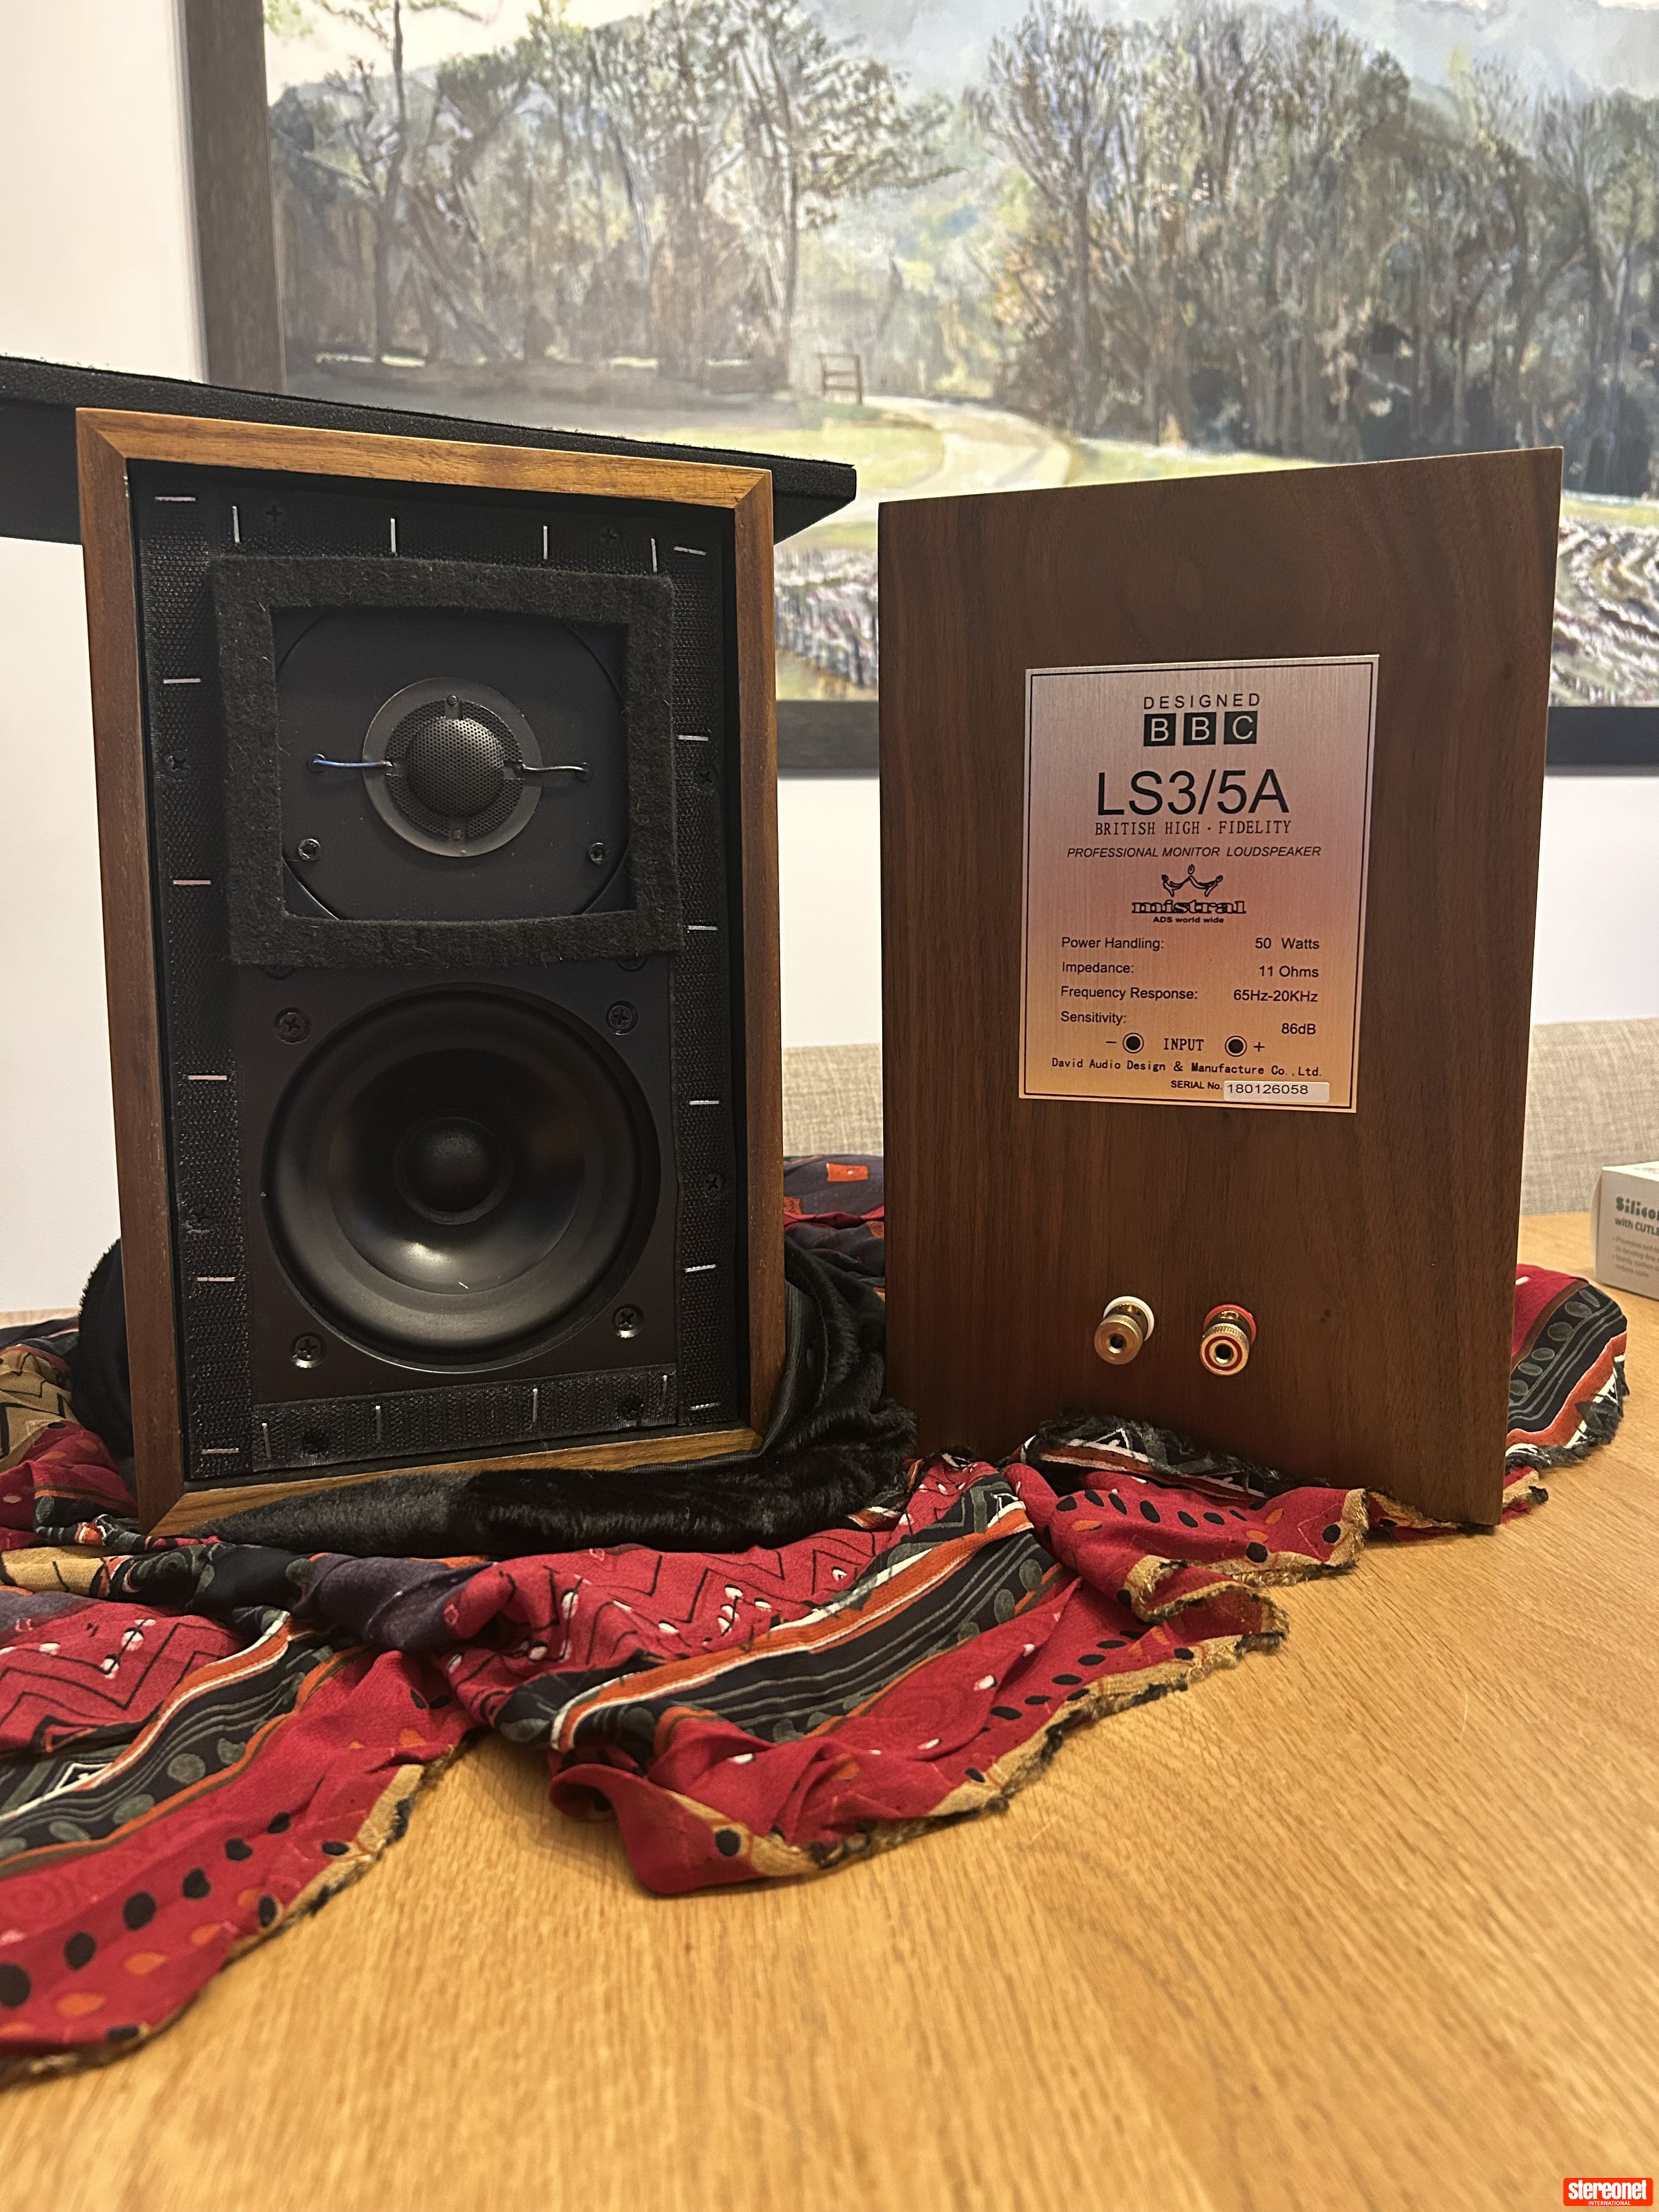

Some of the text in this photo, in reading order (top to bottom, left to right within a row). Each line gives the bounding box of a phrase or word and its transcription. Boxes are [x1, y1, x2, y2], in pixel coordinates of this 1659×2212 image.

[1143, 693, 1260, 710] DESIGNED
[1150, 714, 1254, 742] BBC
[1097, 769, 1290, 816] LS3/5A
[1094, 822, 1155, 836] BRITISH
[1165, 821, 1200, 834] HIGH
[1218, 820, 1291, 834] FIDELITY
[1067, 846, 1322, 858] PROFESSIONAL MONITOR LOUDSPEAKER
[1131, 899, 1247, 915] mistral
[1062, 936, 1320, 952] Power Handling: 50 Watts
[1062, 961, 1319, 978] Impedance: 11 Ohms
[1061, 985, 1318, 1002] Frequency Response: 65Hz-20KHz
[1060, 1011, 1316, 1035] Sensitivity: 86dB
[1163, 1037, 1204, 1051] INPUT
[1052, 1057, 1083, 1068] David
[1089, 1059, 1121, 1069] Audio
[1127, 1060, 1166, 1073] Design
[1173, 1060, 1183, 1072] &
[1191, 1062, 1265, 1075] Manufacture
[1170, 1080, 1308, 1094] SERIAL No. 180126058
[1615, 1218, 1633, 1229] with
